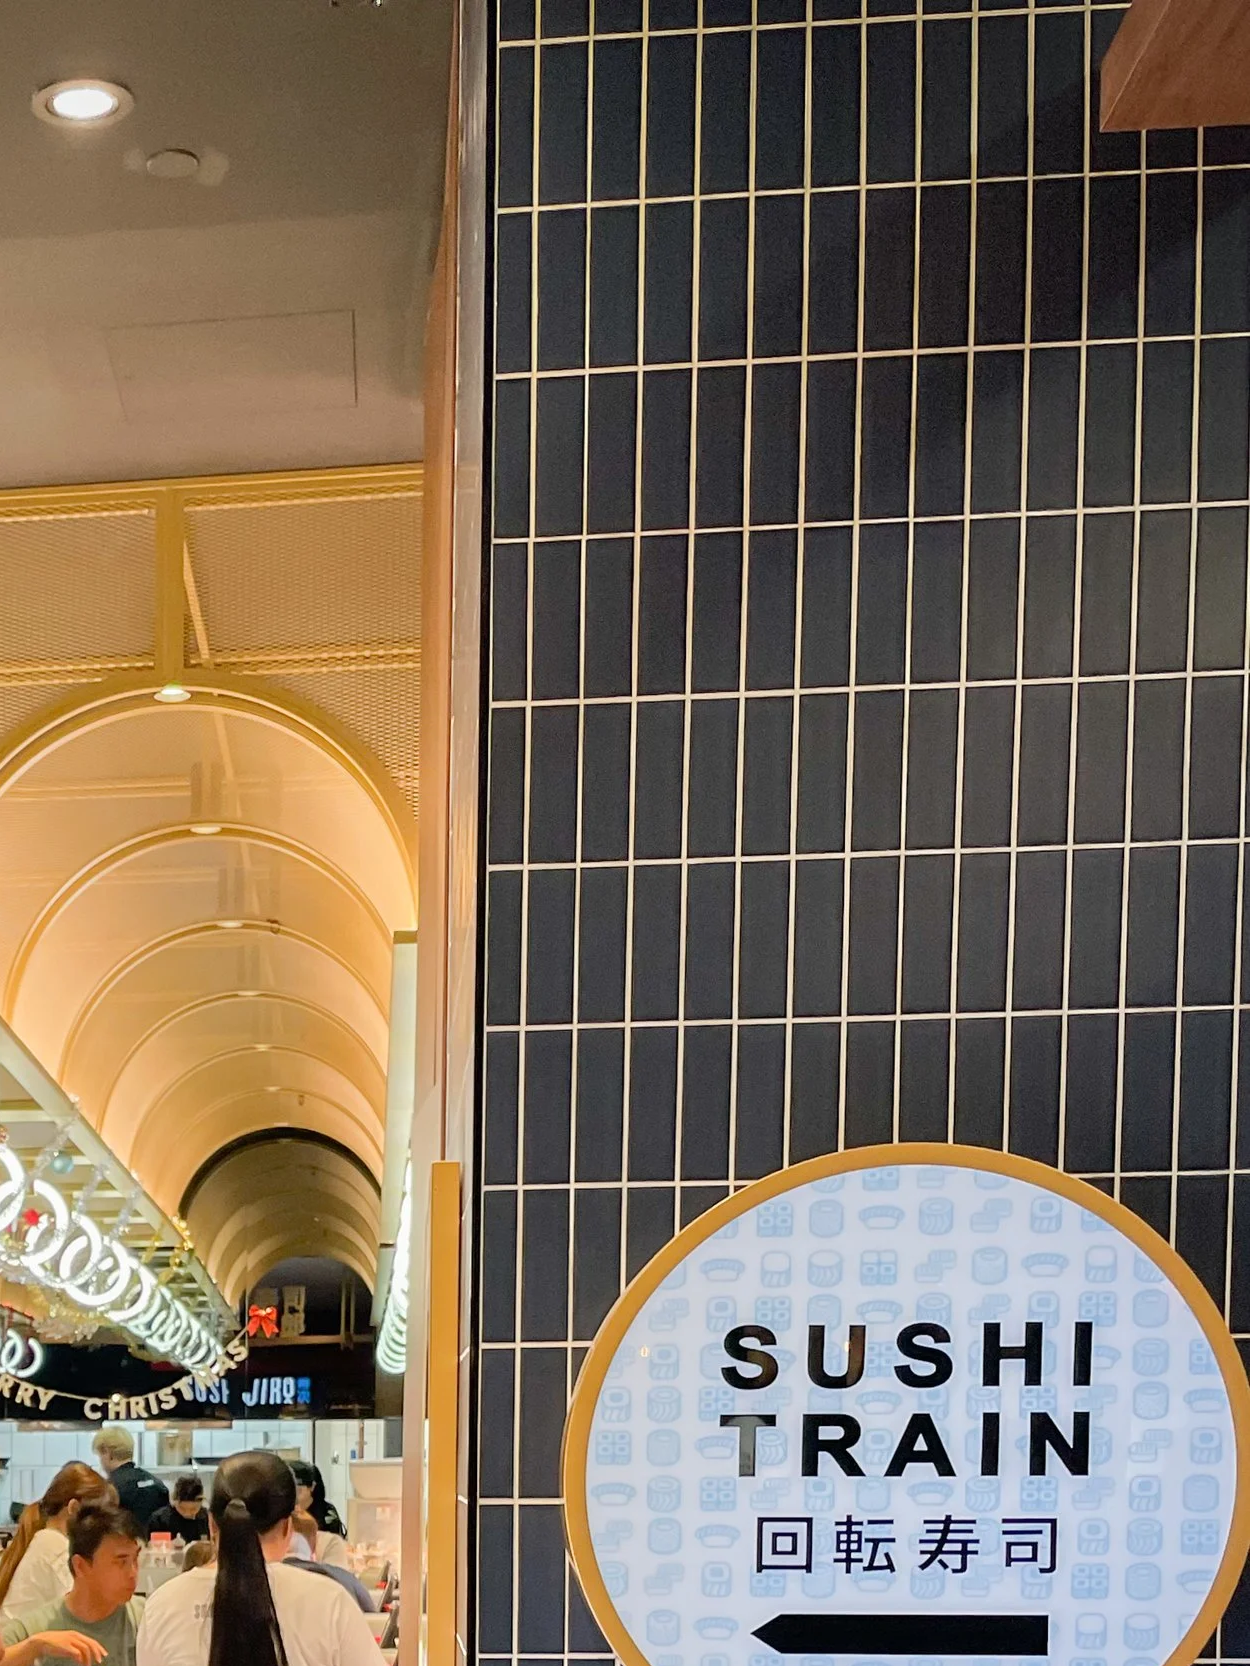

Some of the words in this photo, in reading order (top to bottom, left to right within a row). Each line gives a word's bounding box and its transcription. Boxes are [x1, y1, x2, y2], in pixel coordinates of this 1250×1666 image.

[83, 1340, 248, 1421] CHRISTMAS
[721, 1321, 1093, 1390] SUSHI
[720, 1412, 1090, 1477] TRAIN
[756, 1515, 1058, 1574] 回転寿司
